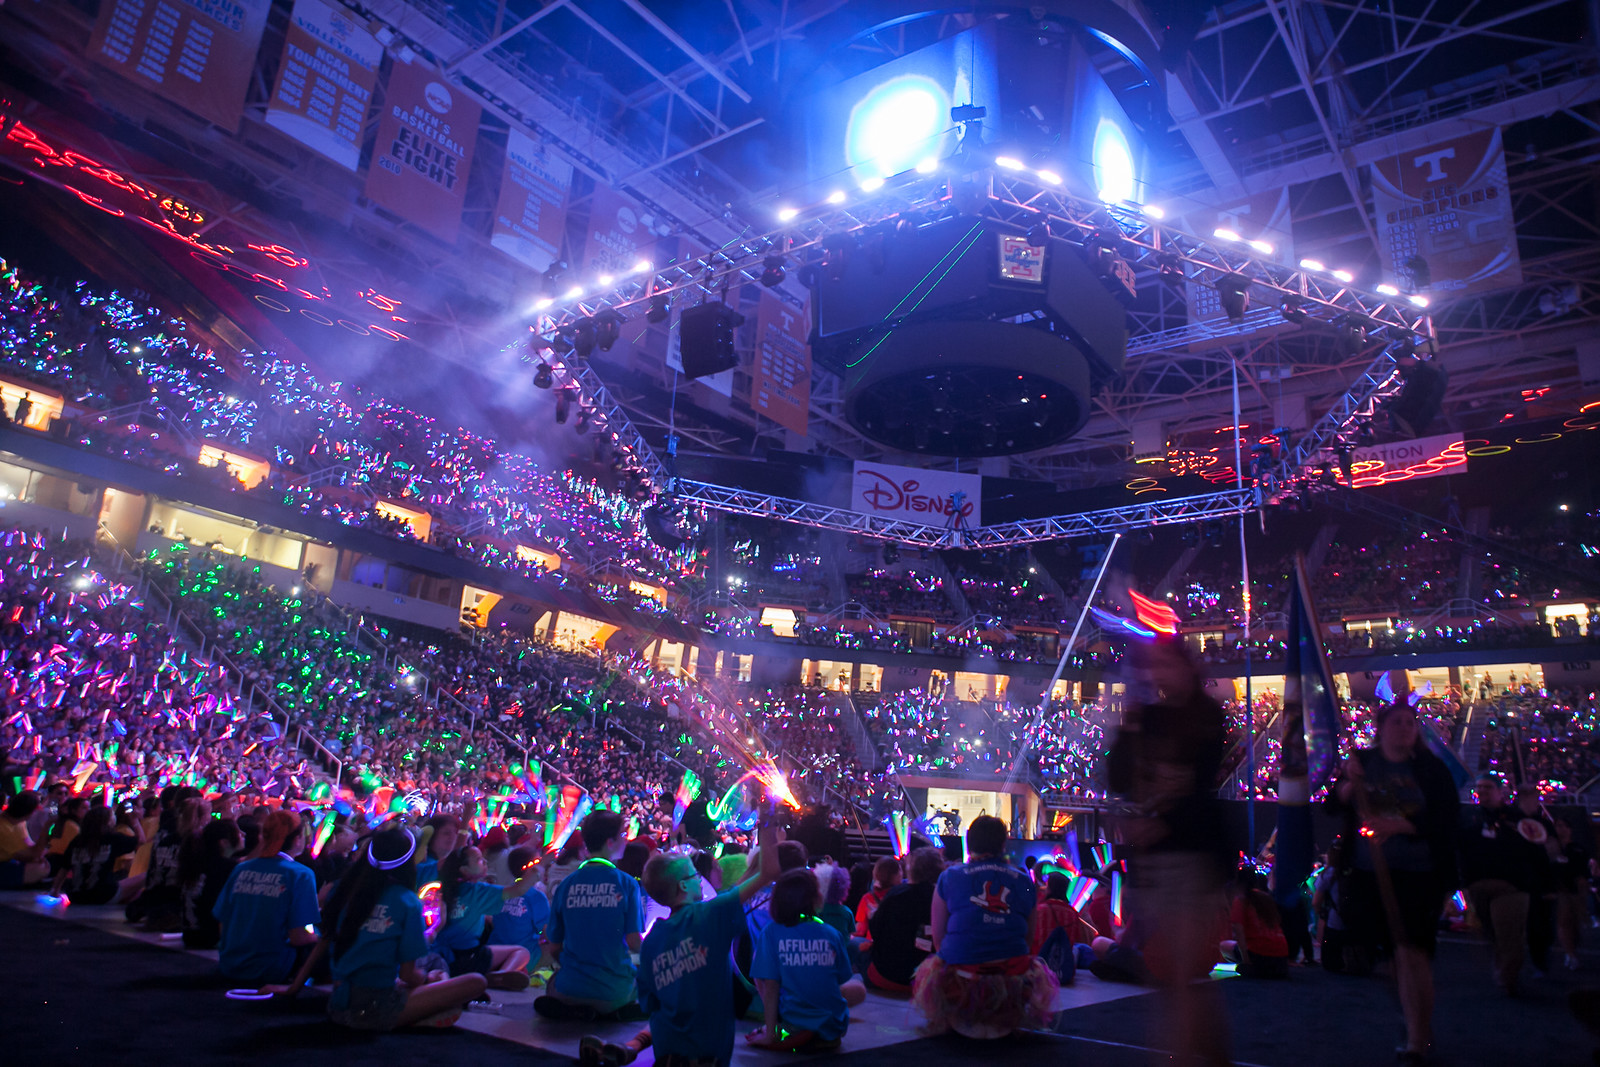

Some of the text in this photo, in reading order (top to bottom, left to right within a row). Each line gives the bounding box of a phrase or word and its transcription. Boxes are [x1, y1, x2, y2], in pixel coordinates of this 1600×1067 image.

[298, 16, 374, 72] VOLLEYBALL
[287, 42, 371, 102] TOURNAMENT
[315, 46, 350, 78] NCAA
[391, 104, 465, 158] BASKETBALL
[413, 104, 452, 136] MEN'S
[379, 155, 401, 176] 2010
[391, 140, 459, 190] EIGHT
[398, 126, 457, 174] ELITE
[1386, 185, 1498, 225] CHAMPIONS
[1428, 212, 1457, 226] 2000
[857, 469, 974, 528] Disney
[233, 881, 282, 899] CHAMPION
[237, 869, 284, 885] AFFILIATE
[568, 883, 617, 897] AFFILIATE
[566, 895, 618, 909] CHAMPION
[983, 912, 1006, 925] Brian
[652, 936, 696, 975] AFFILIATE
[778, 938, 831, 954] AFFILIATE
[778, 952, 837, 968] CHAMPION
[654, 951, 707, 992] CHAMPION
